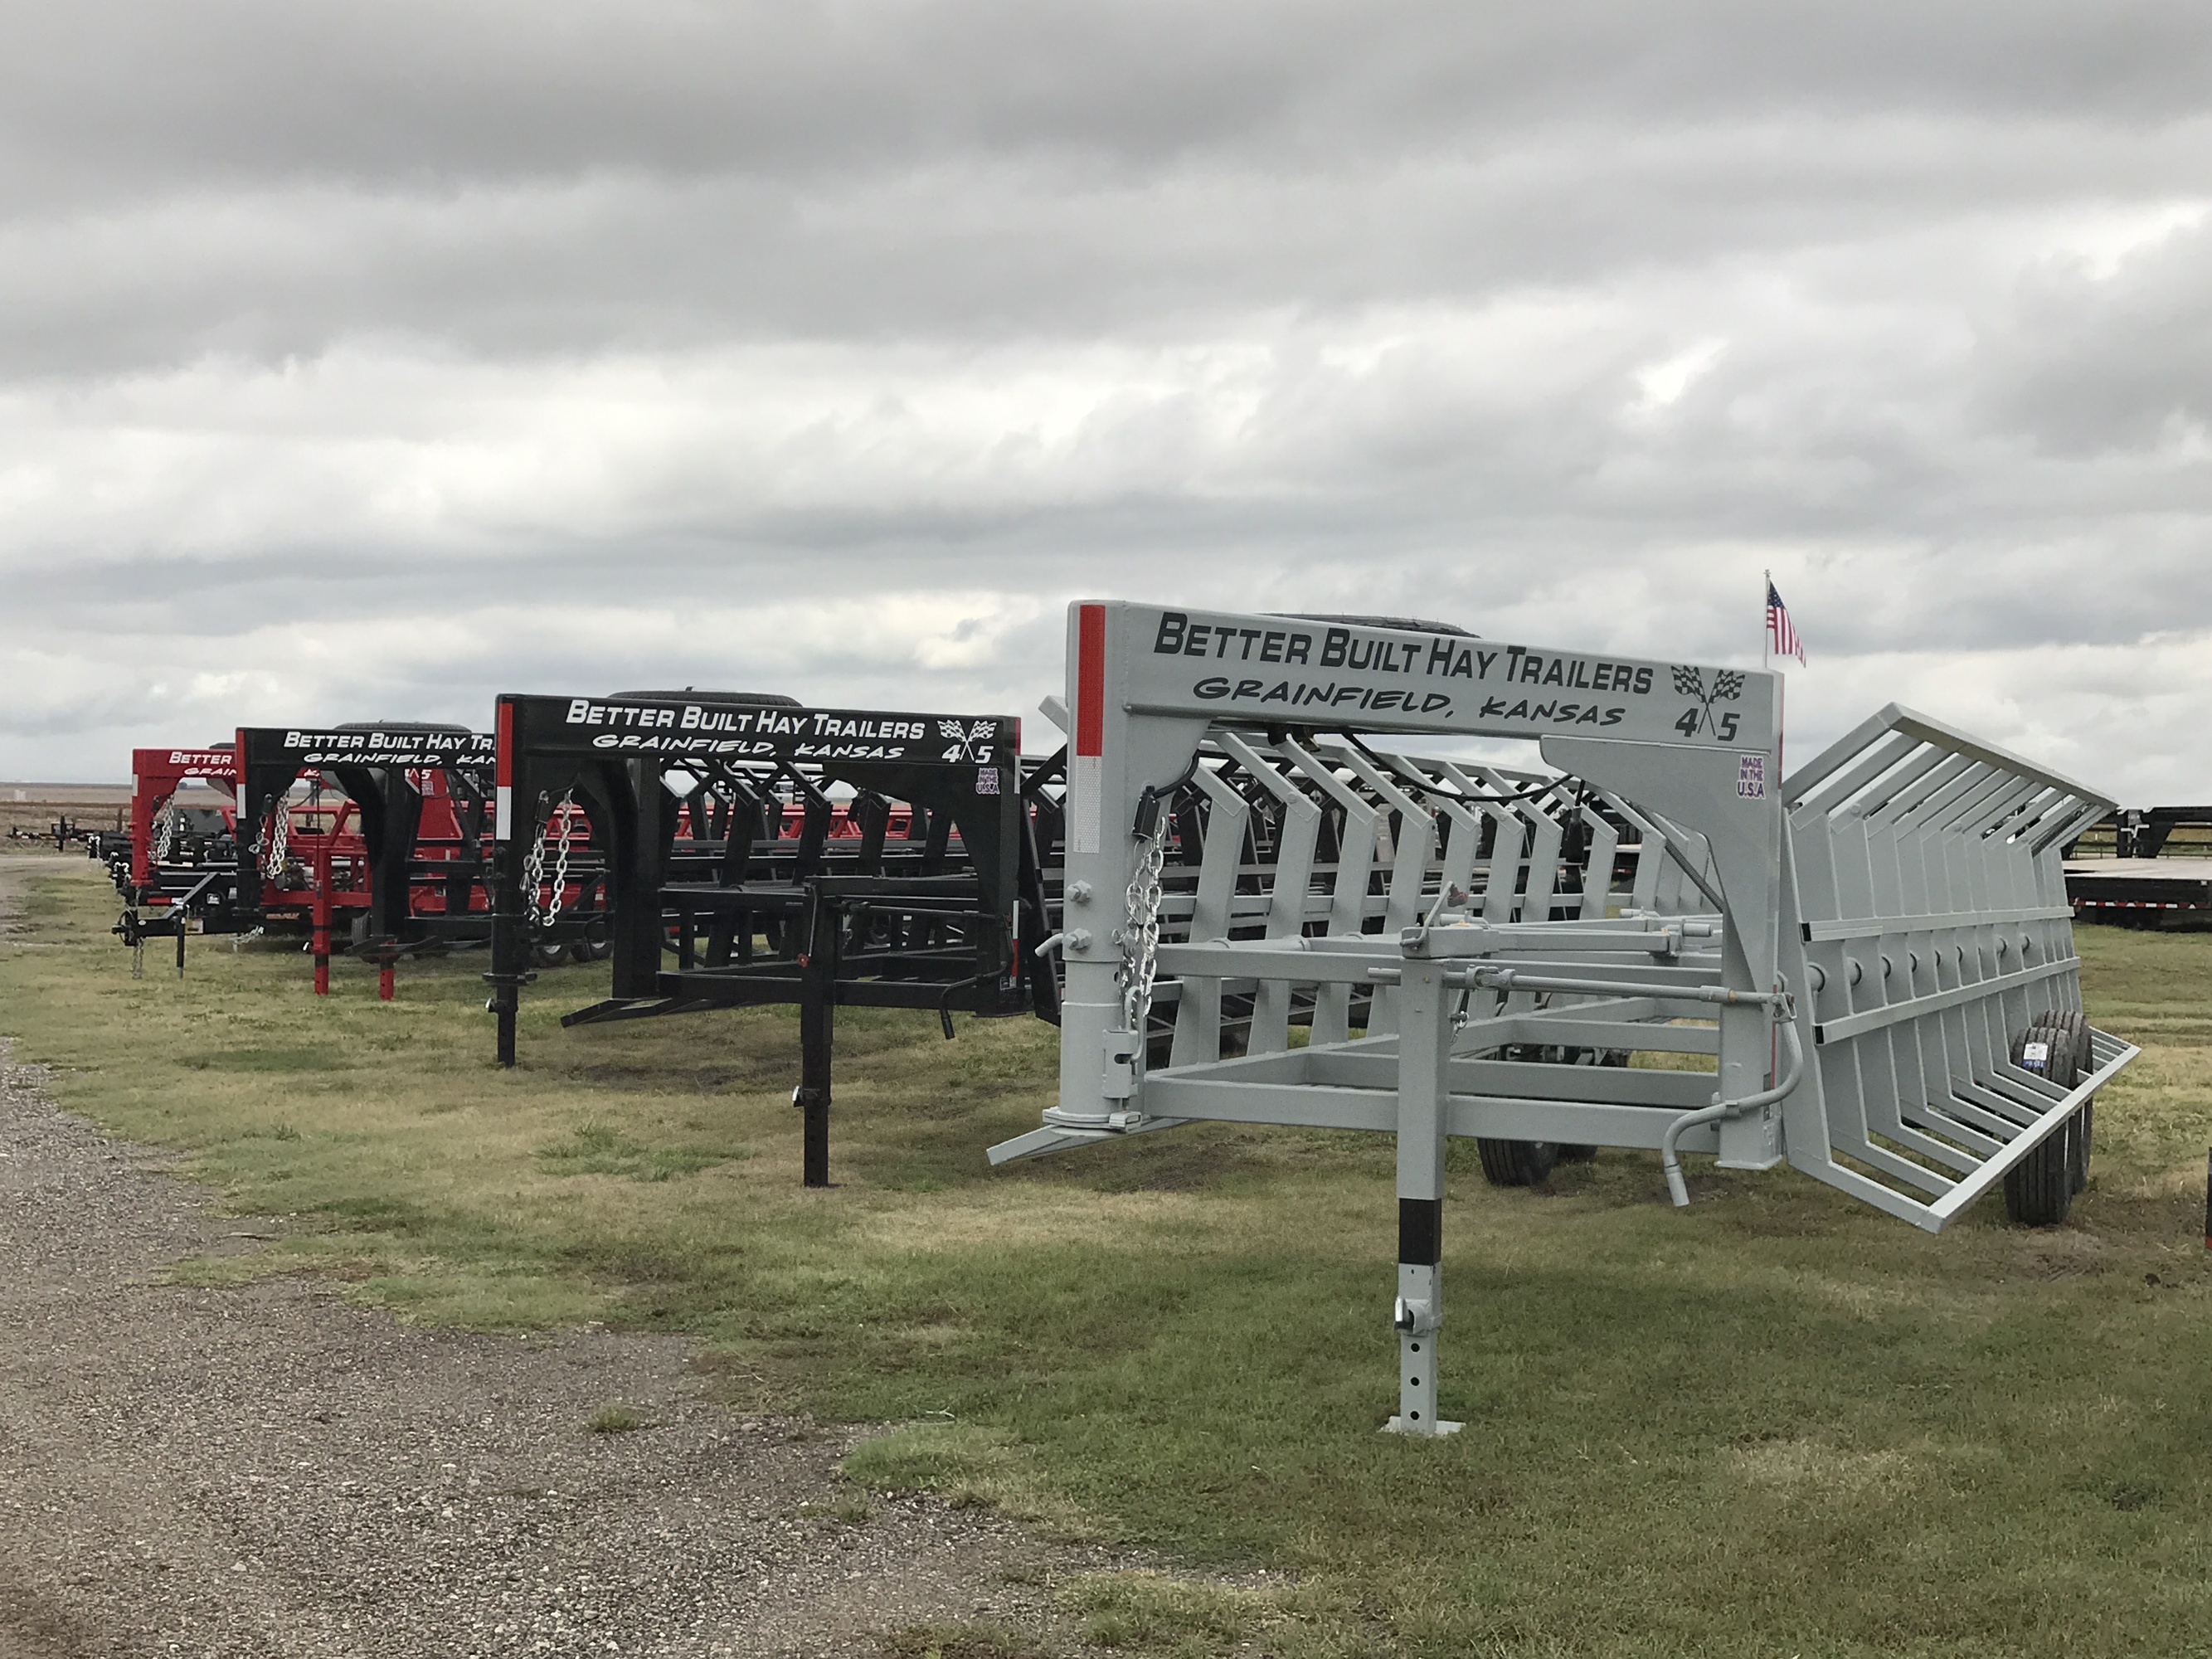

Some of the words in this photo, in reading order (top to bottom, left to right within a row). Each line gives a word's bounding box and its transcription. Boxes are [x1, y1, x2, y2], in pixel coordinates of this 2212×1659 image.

[1154, 611, 1312, 665] BETTER
[1320, 627, 1422, 674] BUILT
[1427, 638, 1498, 679] HAY
[1506, 645, 1654, 694] TRAILERS
[1193, 677, 1455, 718] GRAINFIELD,
[1480, 697, 1626, 726] KANSAS
[566, 699, 675, 728] BETTER
[680, 706, 753, 732] BUILT
[756, 710, 808, 736] HAY
[814, 713, 926, 740] TRAILERS
[284, 731, 365, 748] BETTER
[367, 732, 424, 749] BUILT
[426, 733, 466, 751] HAY
[471, 734, 495, 751] TR
[592, 734, 778, 757] GRAINFIELD,
[794, 742, 905, 760] KANSAS
[168, 751, 232, 765] BETTER
[304, 752, 443, 766] GRAINFIELD,
[1742, 757, 1763, 769] MADE
[980, 768, 997, 776] MADE
[1740, 769, 1748, 781] IN
[1749, 770, 1763, 781] THE
